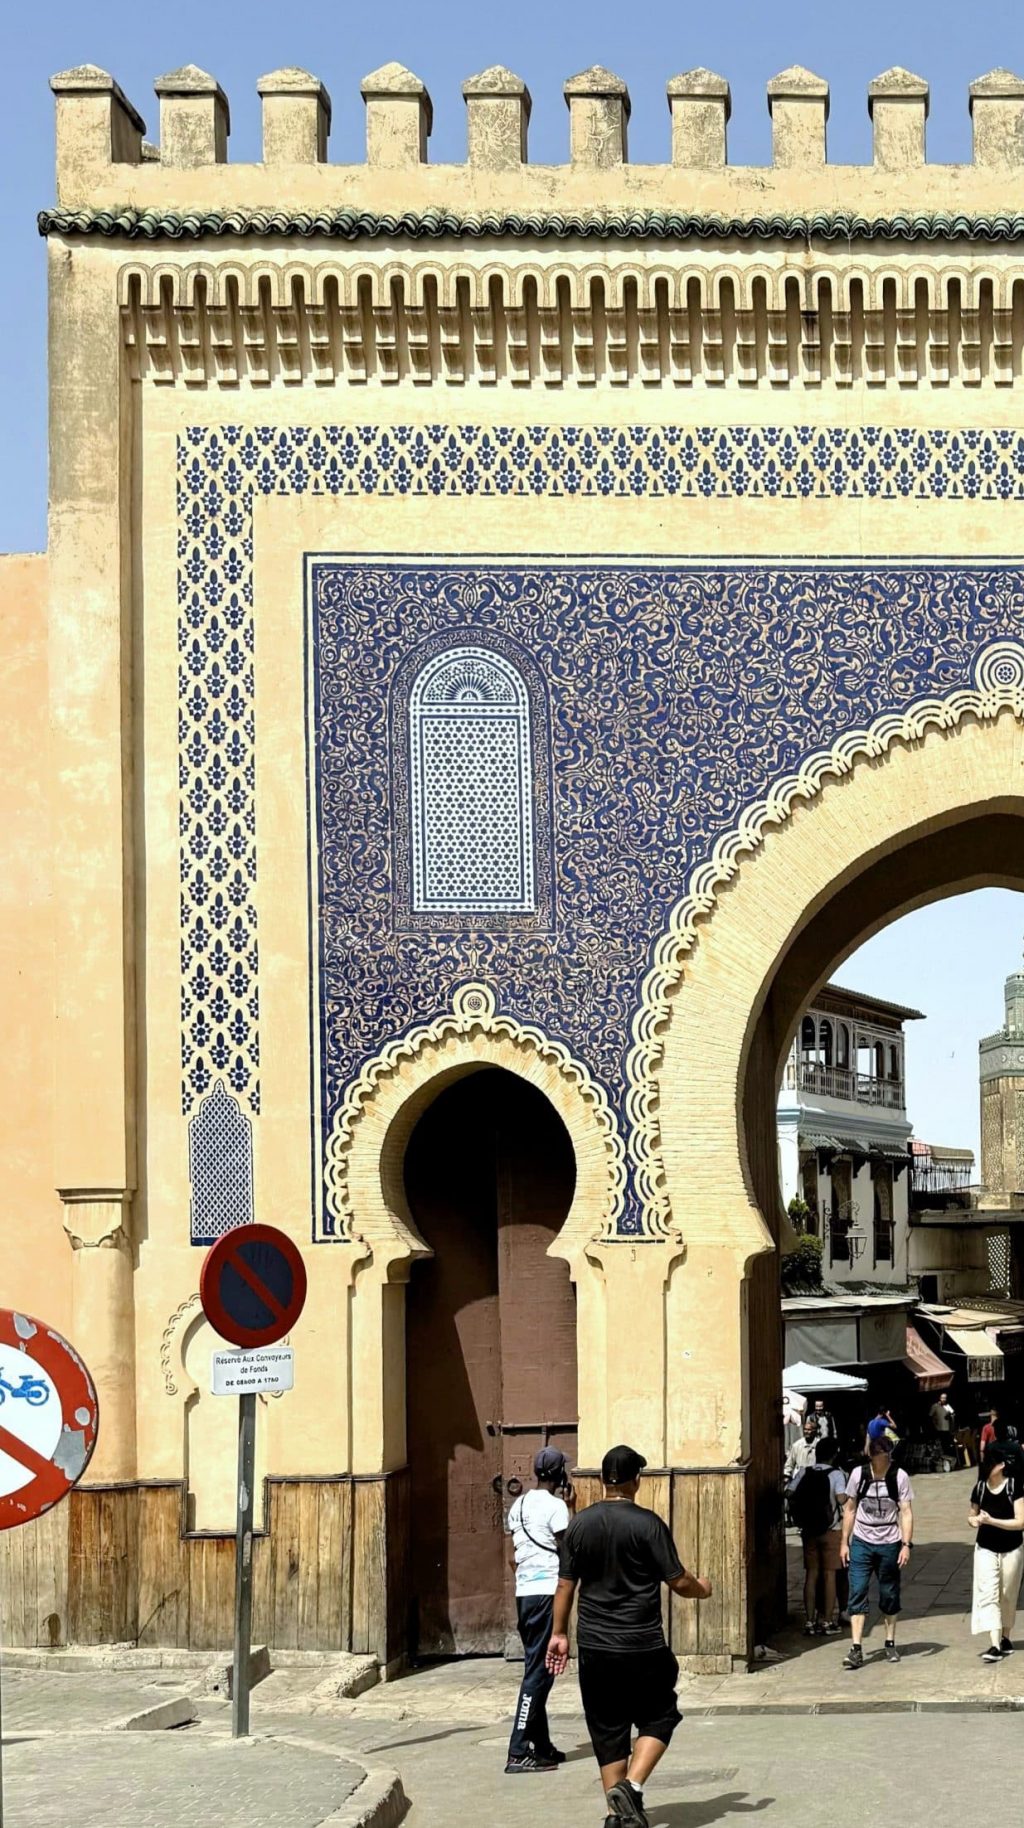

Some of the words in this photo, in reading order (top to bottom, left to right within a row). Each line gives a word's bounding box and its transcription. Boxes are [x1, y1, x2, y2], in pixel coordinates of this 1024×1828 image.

[242, 1355, 254, 1363] Aux
[256, 1353, 291, 1363] Convoyeurs
[240, 1366, 248, 1374] de
[517, 1693, 532, 1730] Joma
